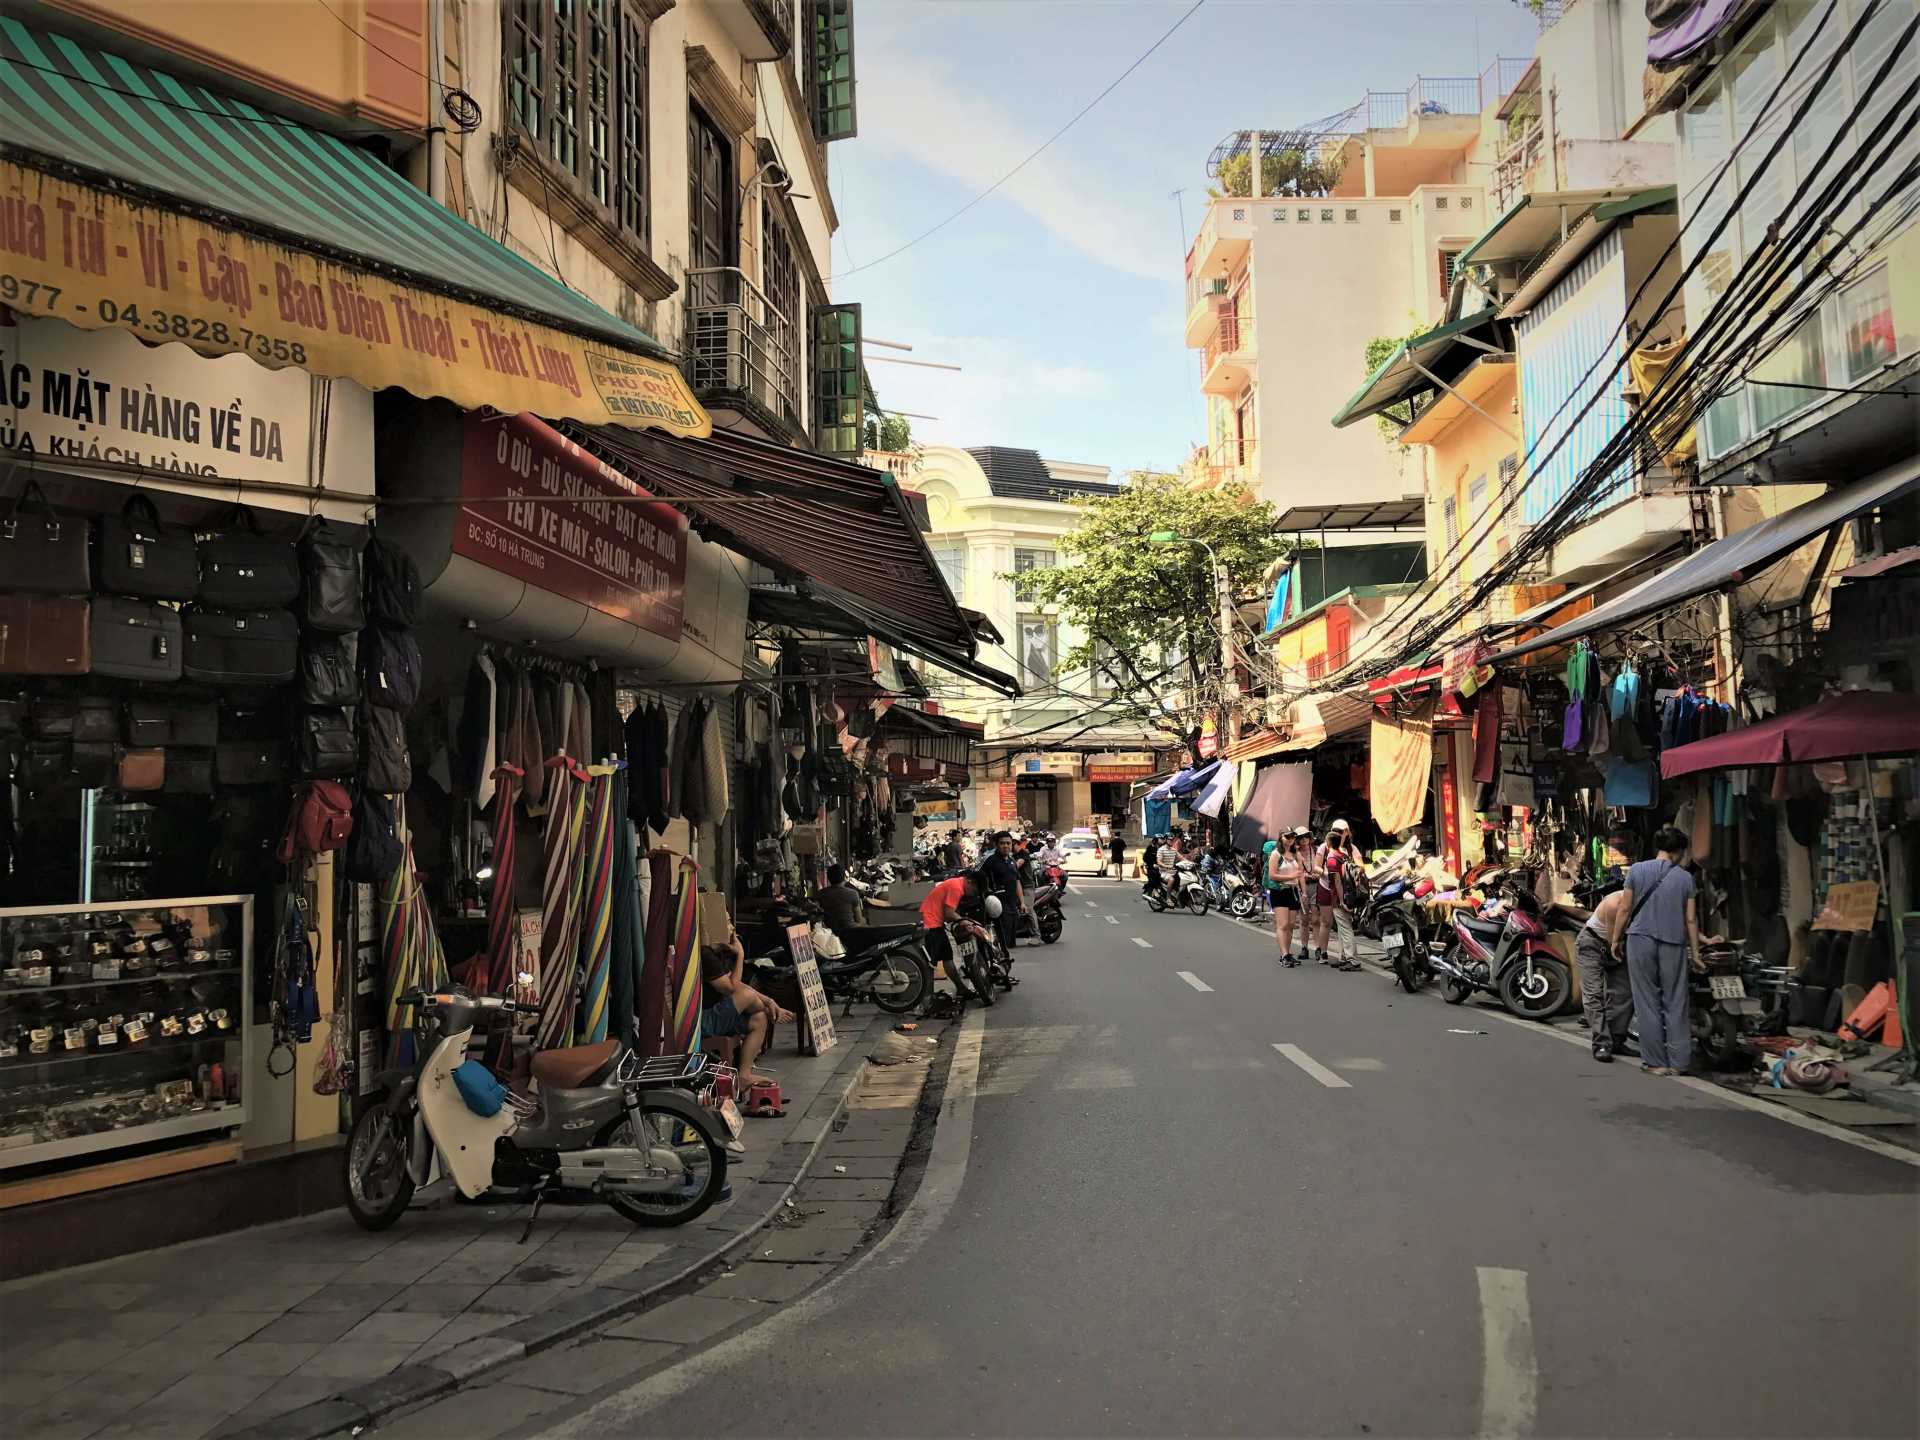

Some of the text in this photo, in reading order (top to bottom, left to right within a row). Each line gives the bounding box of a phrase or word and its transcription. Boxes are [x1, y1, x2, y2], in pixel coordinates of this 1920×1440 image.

[98, 299, 308, 364] 04.3828.7358
[275, 262, 328, 331] Bao
[329, 278, 391, 350] Điện
[390, 294, 458, 367] Thoại
[42, 367, 110, 431] MẶT
[121, 383, 200, 444] HÀNG
[209, 397, 242, 454] VỀ
[250, 416, 284, 463] DA
[50, 435, 140, 464] KHÁCH
[507, 486, 535, 532] YÊN
[538, 504, 558, 544] XE
[560, 517, 589, 560] MÁY
[594, 536, 630, 579] SALON
[510, 437, 532, 478] DÙ
[541, 456, 561, 496] DÙ
[616, 503, 637, 542] BẠT
[637, 517, 656, 552] CHE
[485, 528, 498, 549] SỐ
[520, 546, 545, 569] TRUNG
